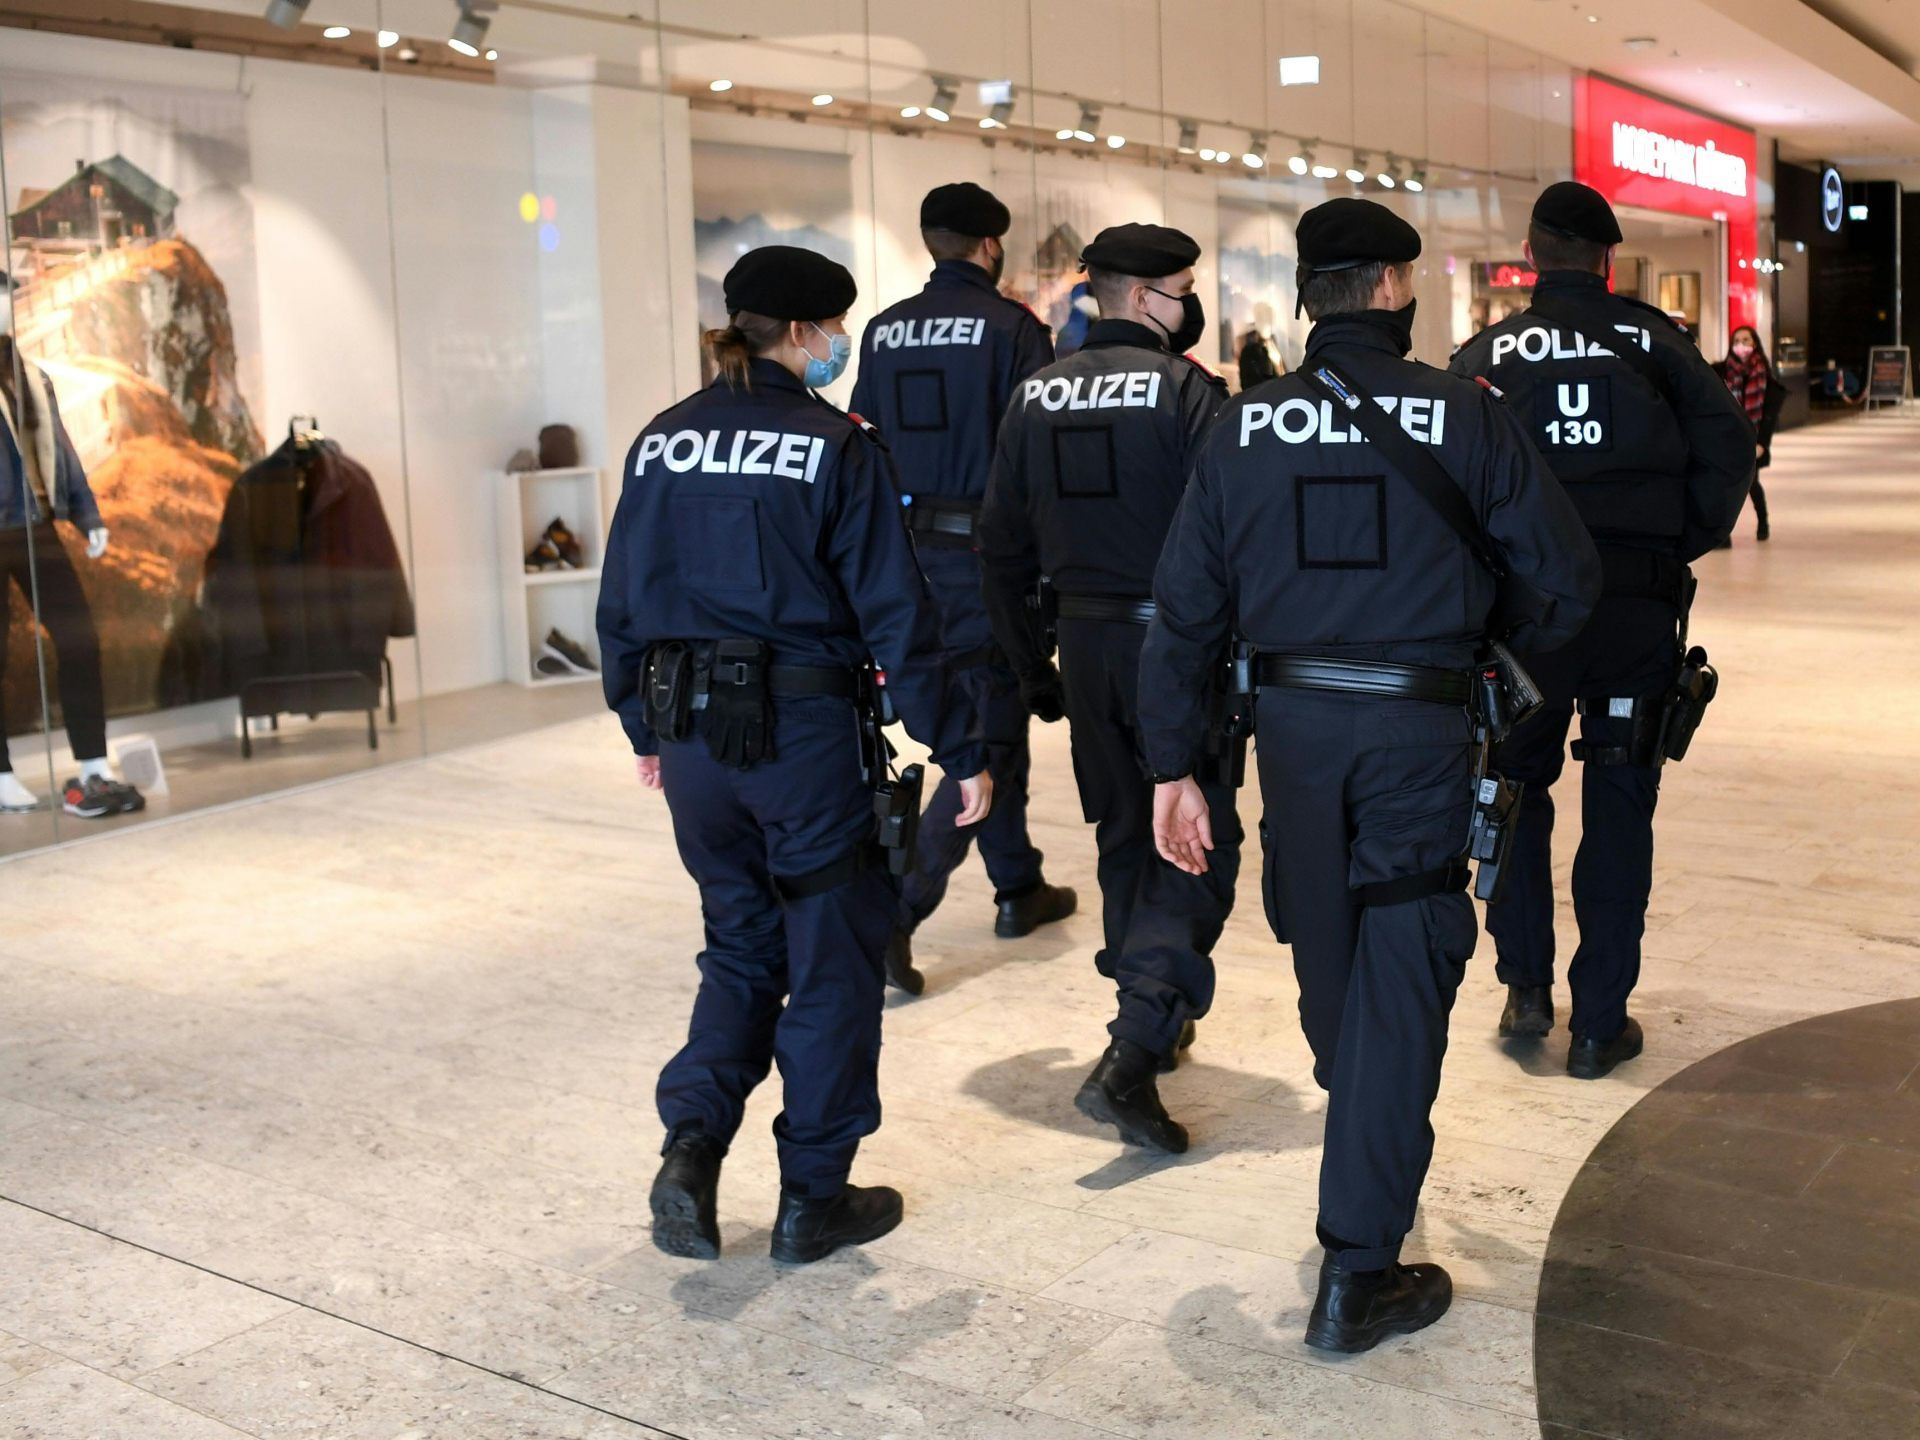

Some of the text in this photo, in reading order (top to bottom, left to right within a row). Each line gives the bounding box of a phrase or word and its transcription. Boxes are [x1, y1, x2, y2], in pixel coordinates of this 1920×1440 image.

[873, 316, 986, 352] POLIZEI
[1492, 325, 1651, 366] POLII
[1023, 371, 1162, 412] POLIZEI
[1557, 384, 1590, 417] U
[1545, 420, 1603, 445] 130
[634, 429, 825, 484] POLIZEI
